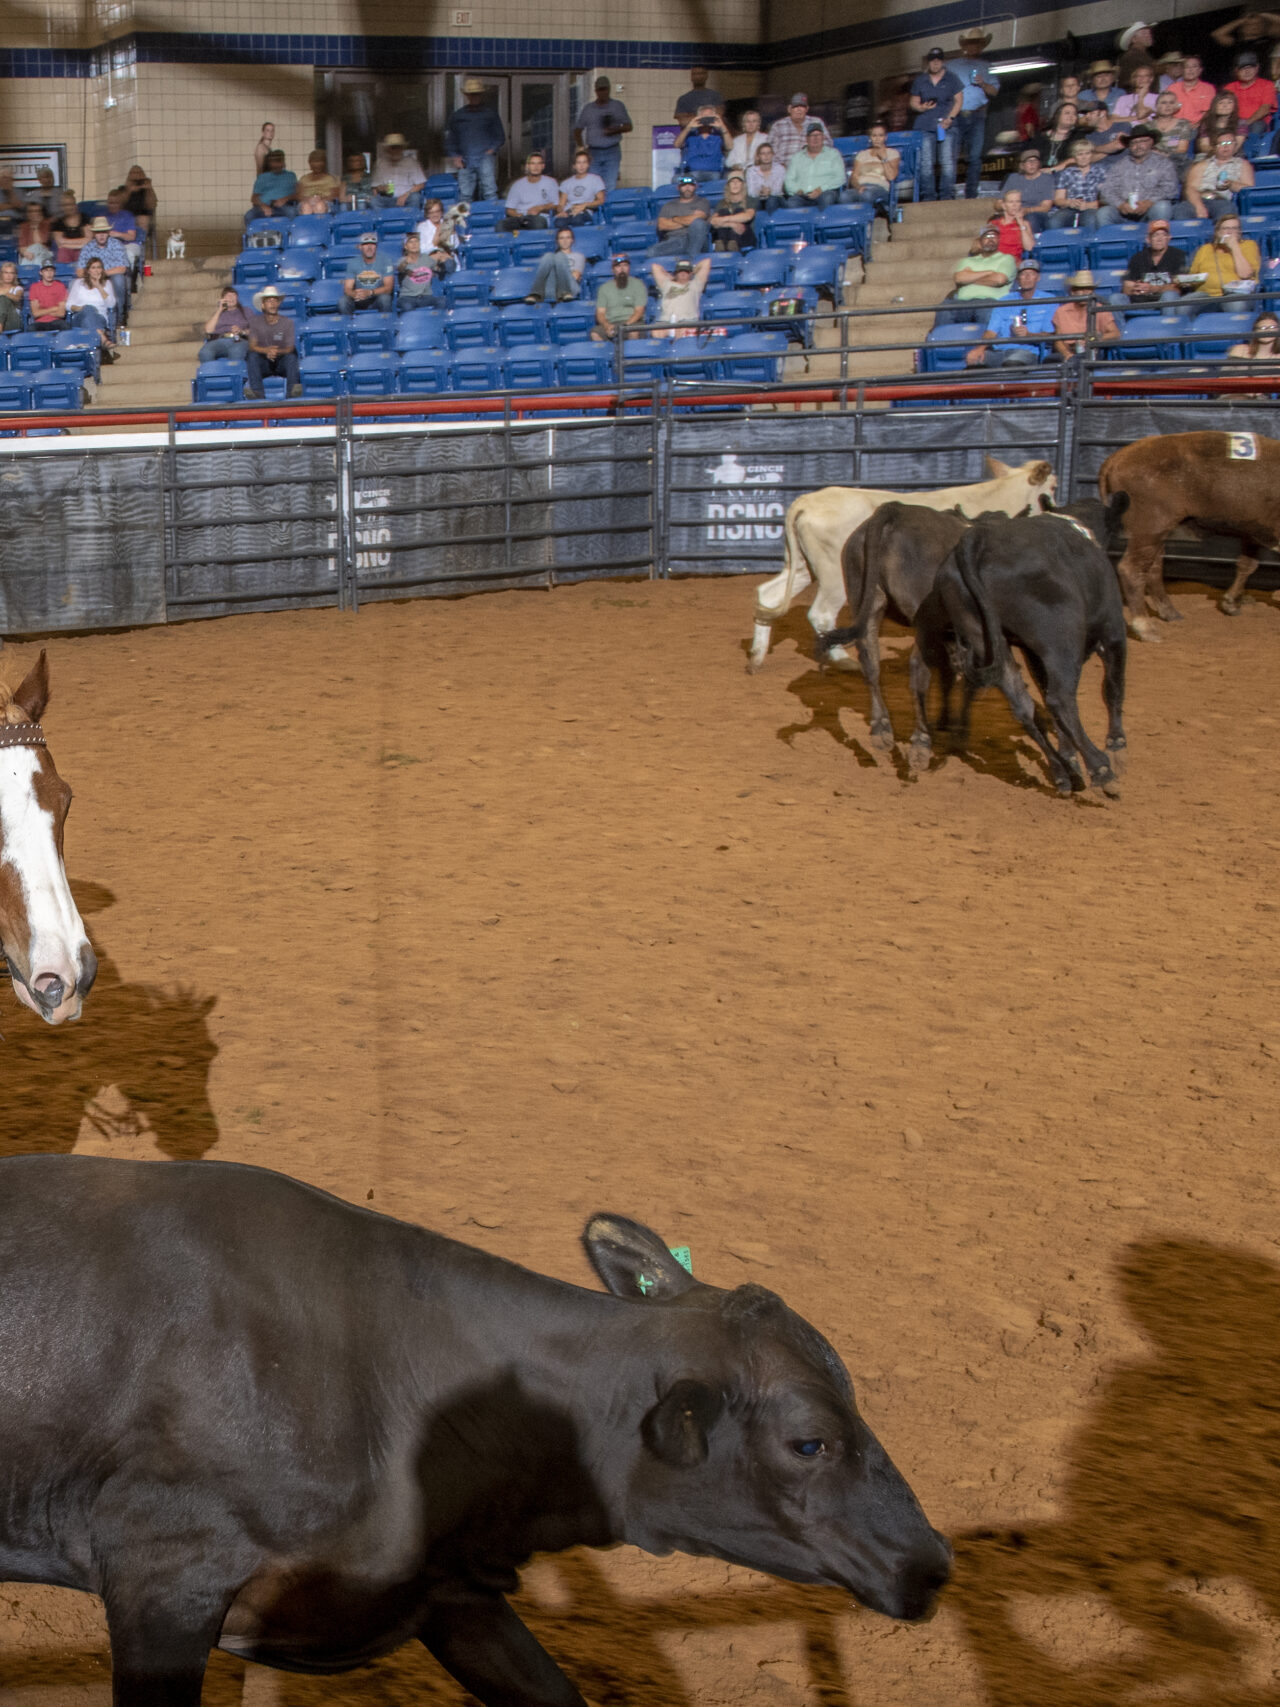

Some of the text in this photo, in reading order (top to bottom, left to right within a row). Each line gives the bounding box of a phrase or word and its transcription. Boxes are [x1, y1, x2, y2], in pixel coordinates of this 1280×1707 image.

[1233, 433, 1254, 457] 3
[747, 465, 784, 473] CINCH
[362, 489, 391, 498] CINCH
[707, 503, 784, 540] RSNC
